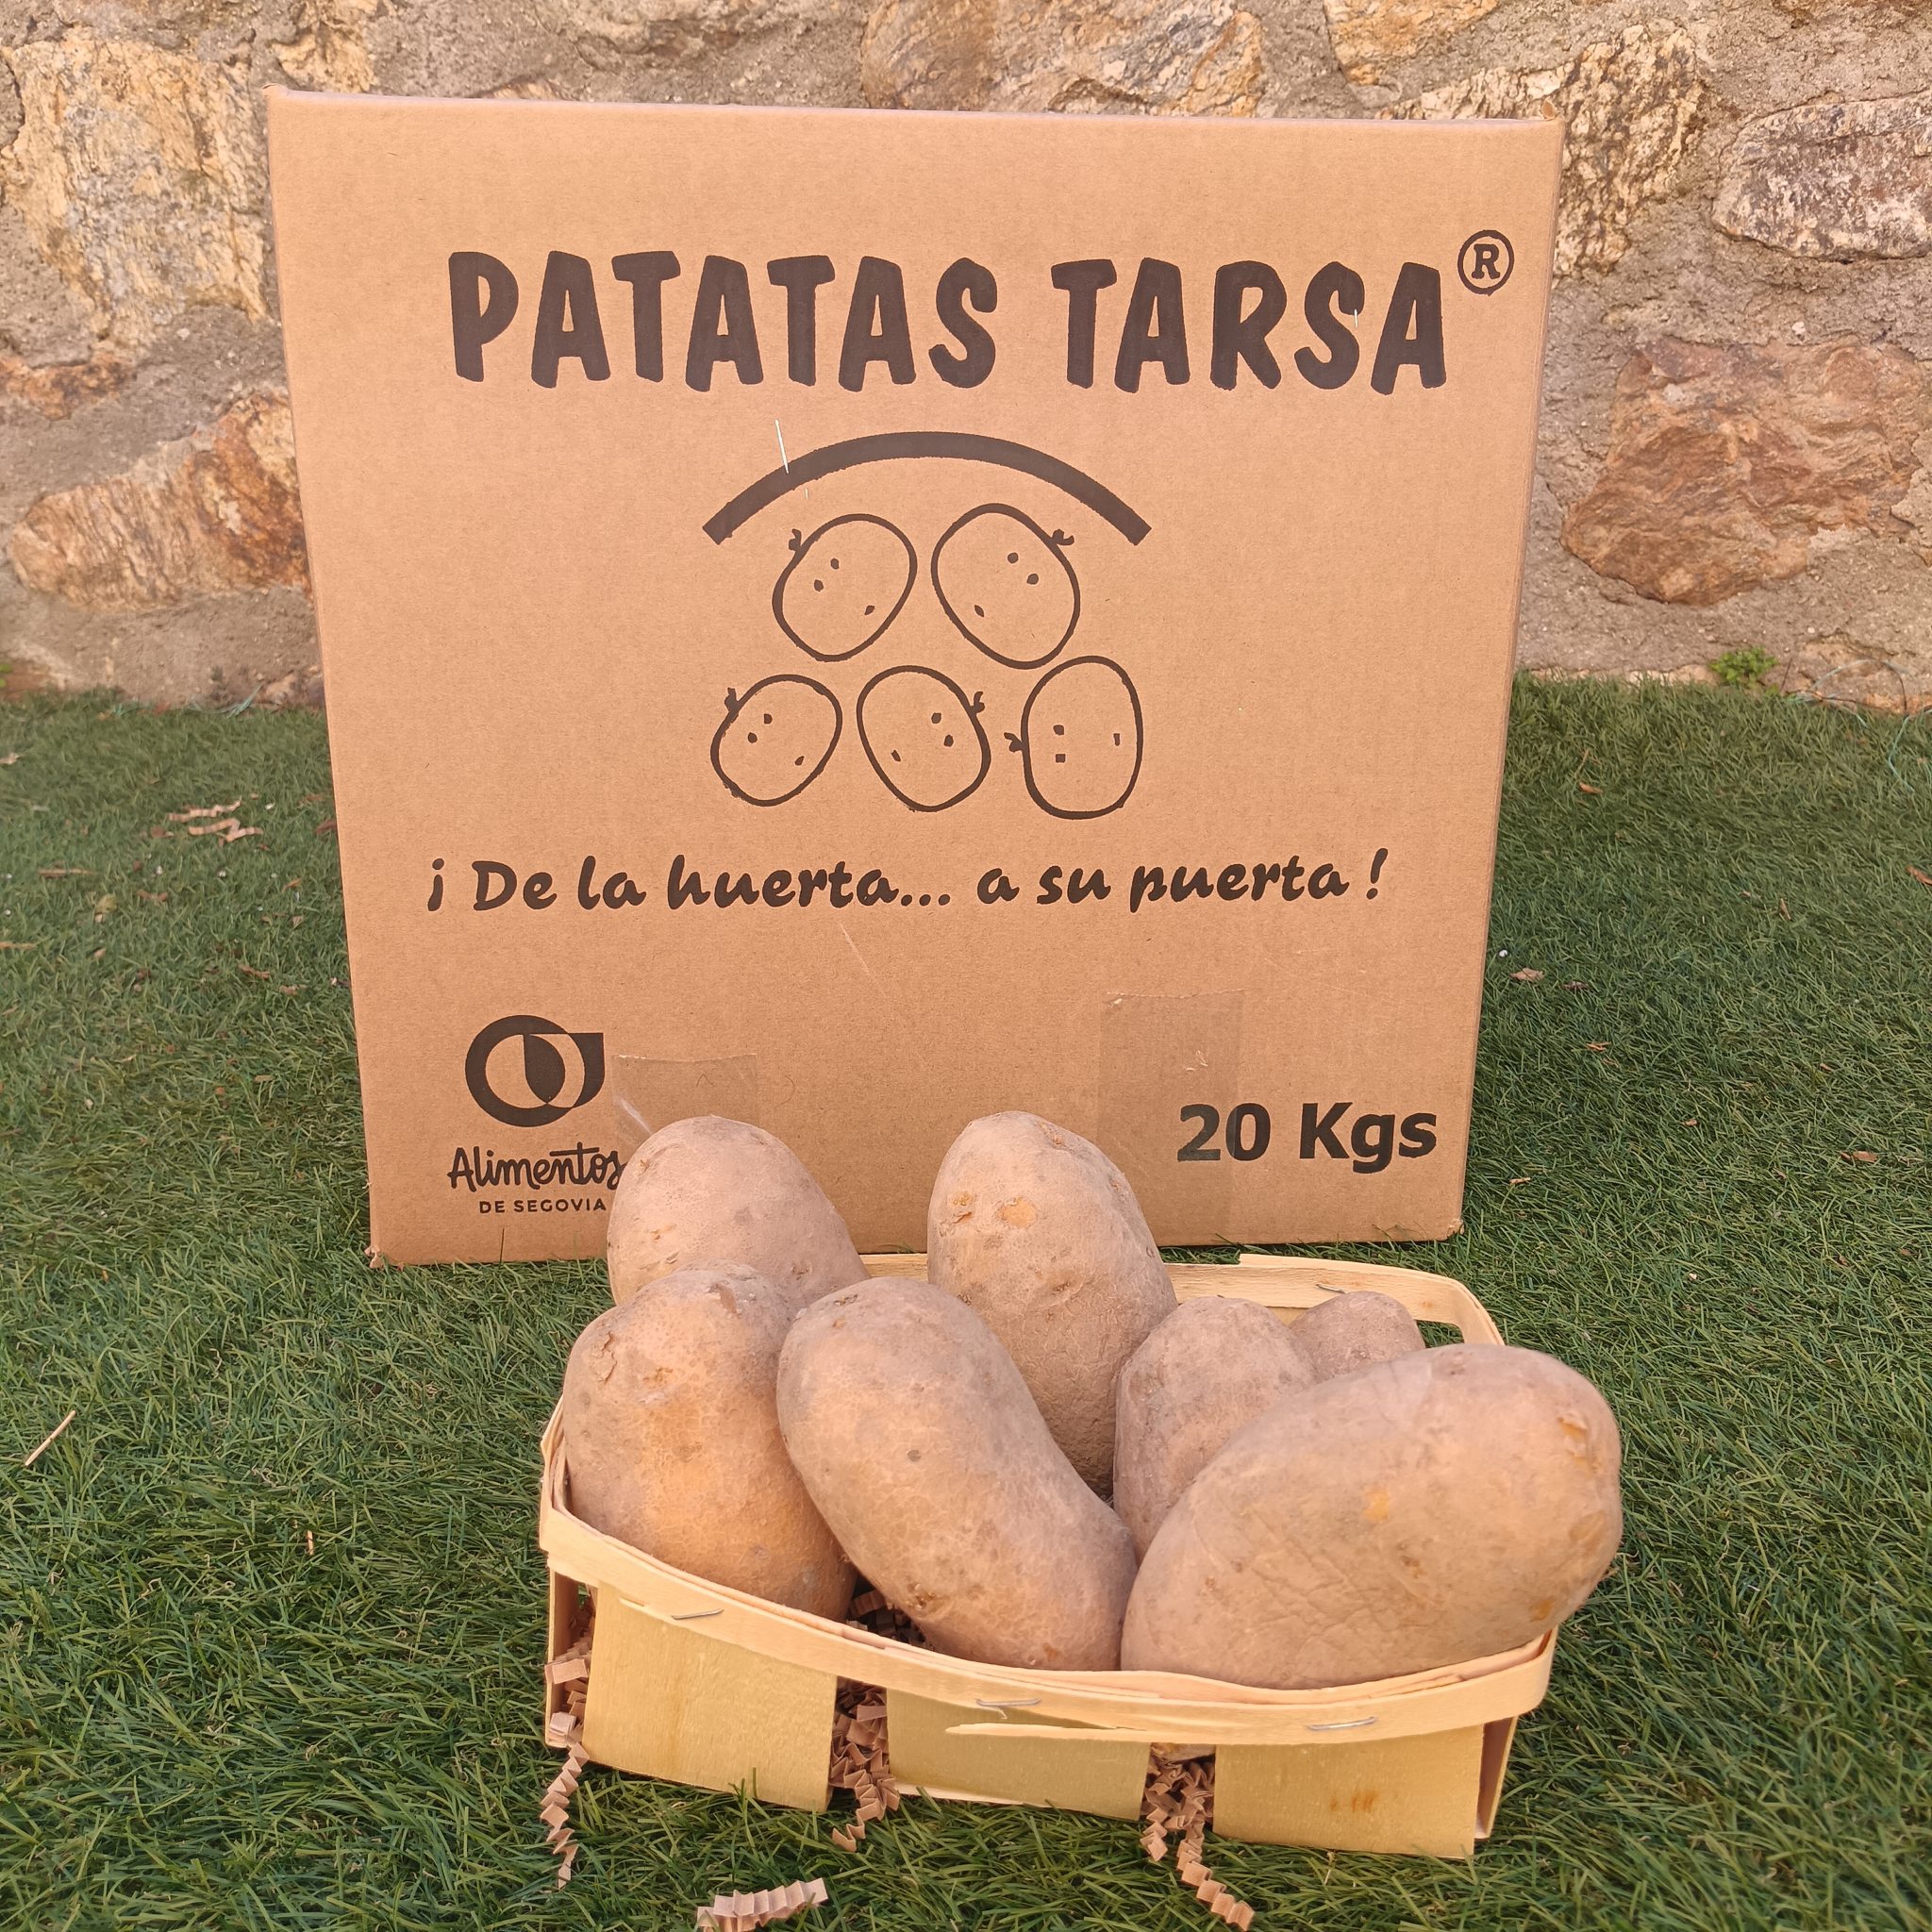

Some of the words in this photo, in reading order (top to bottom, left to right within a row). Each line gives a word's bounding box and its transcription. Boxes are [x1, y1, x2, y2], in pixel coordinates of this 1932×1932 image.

[448, 250, 998, 391] PATATAS
[471, 859, 558, 911] De
[577, 855, 647, 910] la
[667, 855, 952, 910] huerta...
[976, 867, 1021, 905] a
[1036, 865, 1111, 905] su
[1129, 855, 1350, 914] puerta
[447, 1141, 628, 1193] Alimentos
[1176, 1102, 1272, 1162] 20
[1298, 1101, 1438, 1174] Kgs
[479, 1200, 506, 1214] DE
[513, 1197, 607, 1213] SEGOVIA
